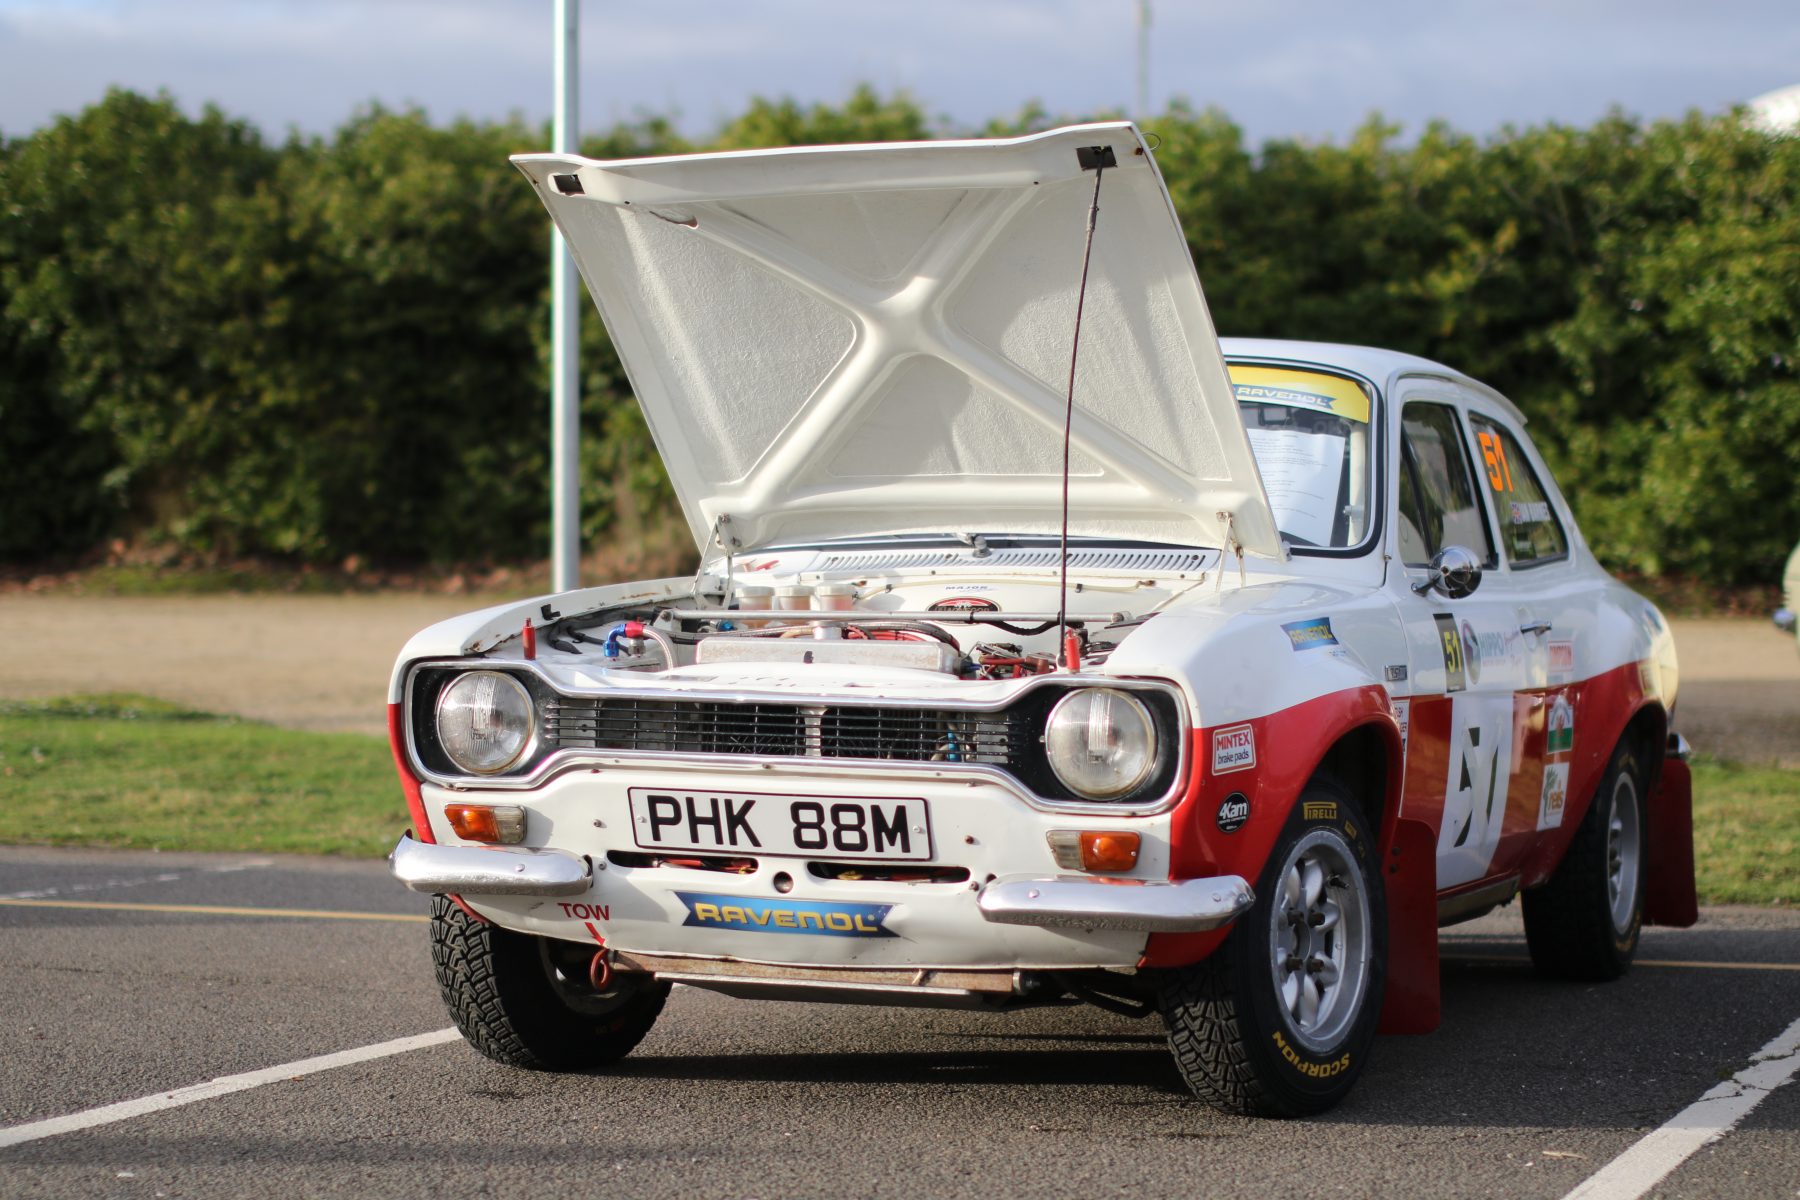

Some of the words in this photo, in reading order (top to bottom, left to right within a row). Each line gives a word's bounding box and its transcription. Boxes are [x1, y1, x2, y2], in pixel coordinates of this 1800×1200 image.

[1478, 431, 1514, 493] 51
[1444, 630, 1462, 673] 51
[1216, 731, 1251, 751] MINTEX
[1217, 752, 1234, 765] brake
[1234, 749, 1250, 764] pads
[1219, 802, 1247, 820] 4Kam
[1303, 801, 1337, 820] PIRELLI
[647, 794, 762, 848] PHK
[790, 801, 911, 854] 88M
[557, 902, 610, 921] TOW
[695, 902, 878, 932] RAVENOL
[1272, 1031, 1350, 1078] SCORPION
